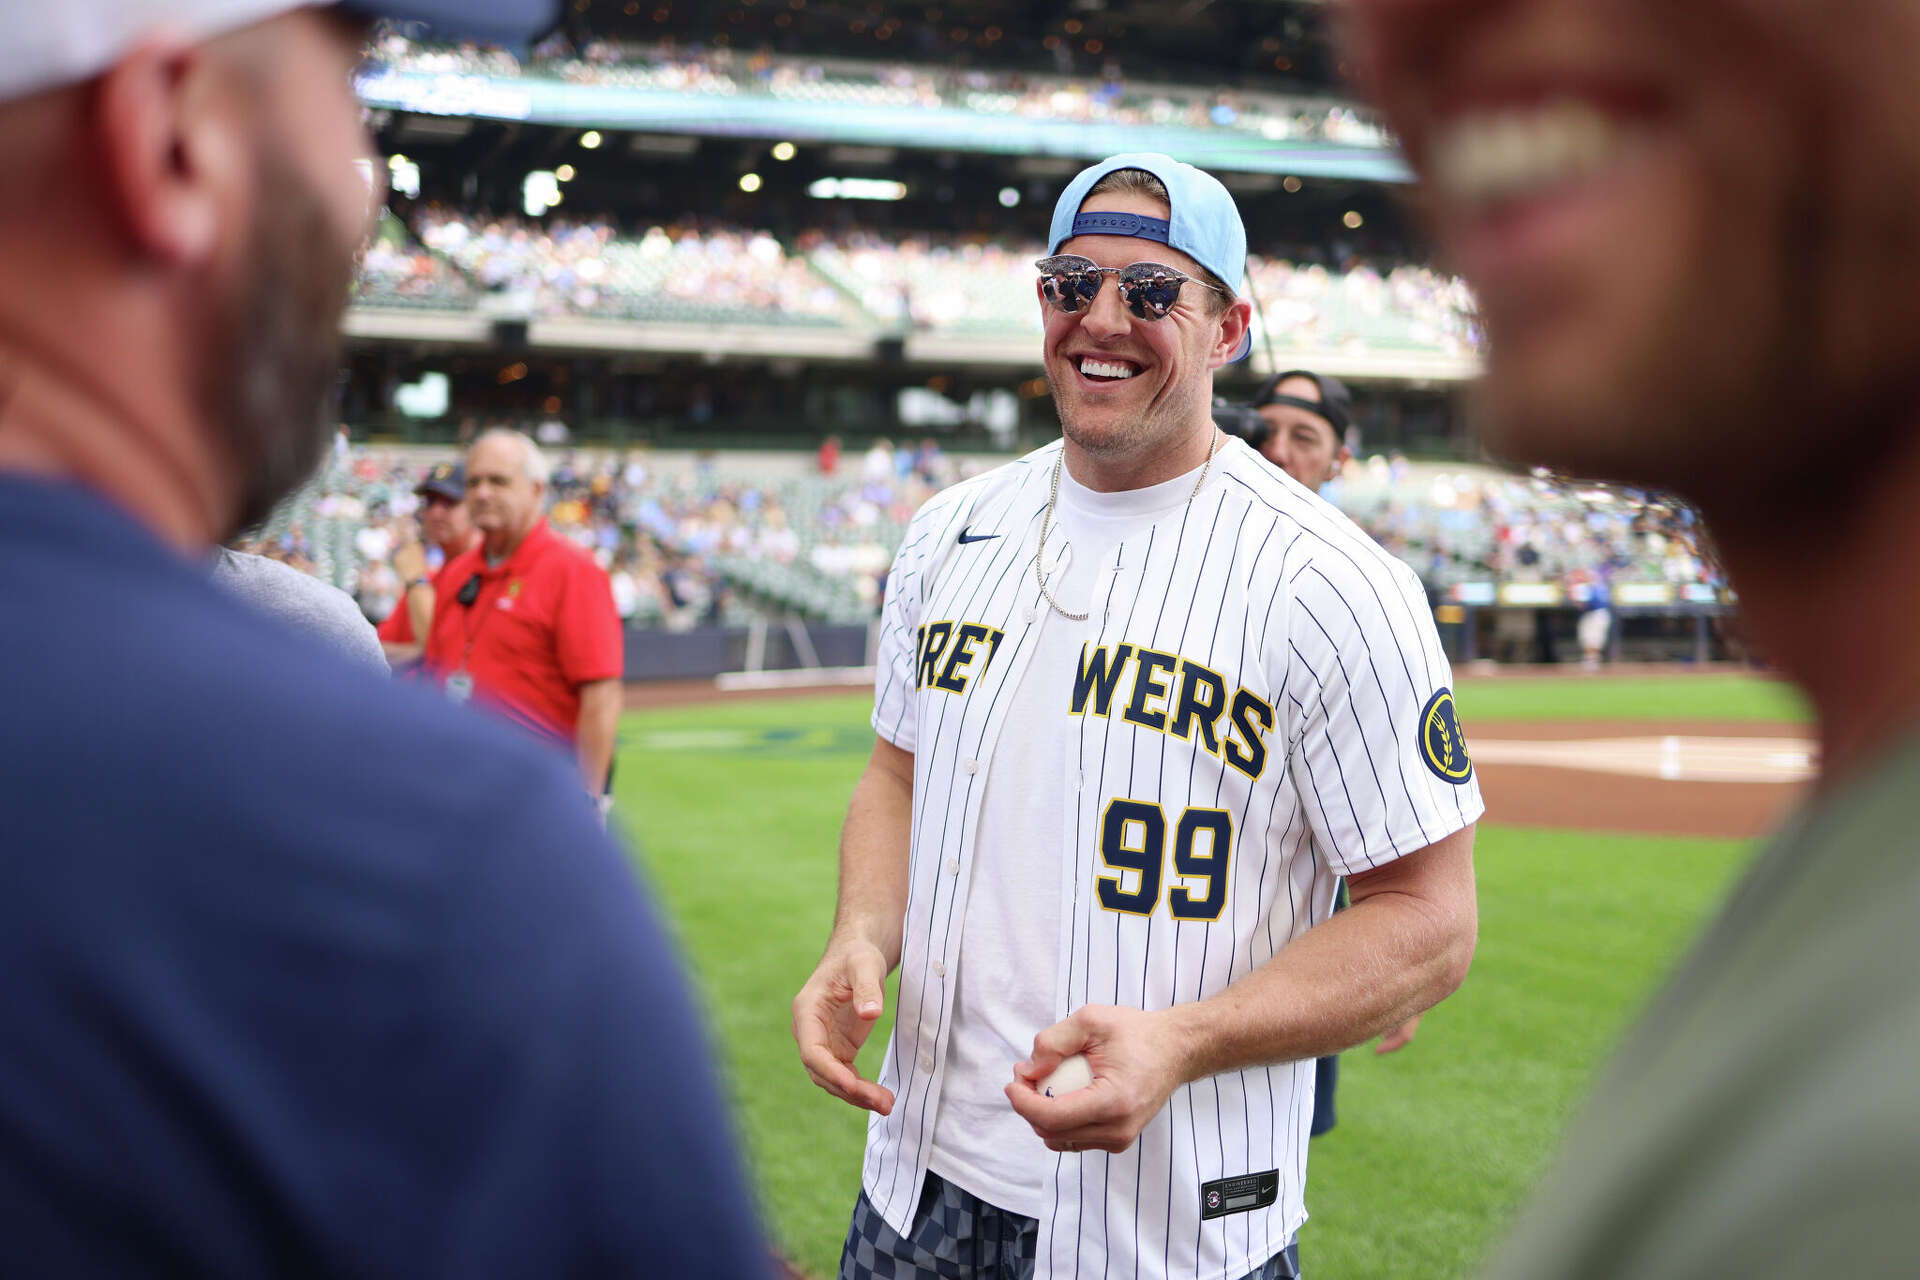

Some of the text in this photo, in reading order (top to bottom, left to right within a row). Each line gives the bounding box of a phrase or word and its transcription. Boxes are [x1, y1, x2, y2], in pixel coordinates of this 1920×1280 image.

[916, 620, 1275, 782] RE WERS
[1095, 797, 1234, 922] 99
